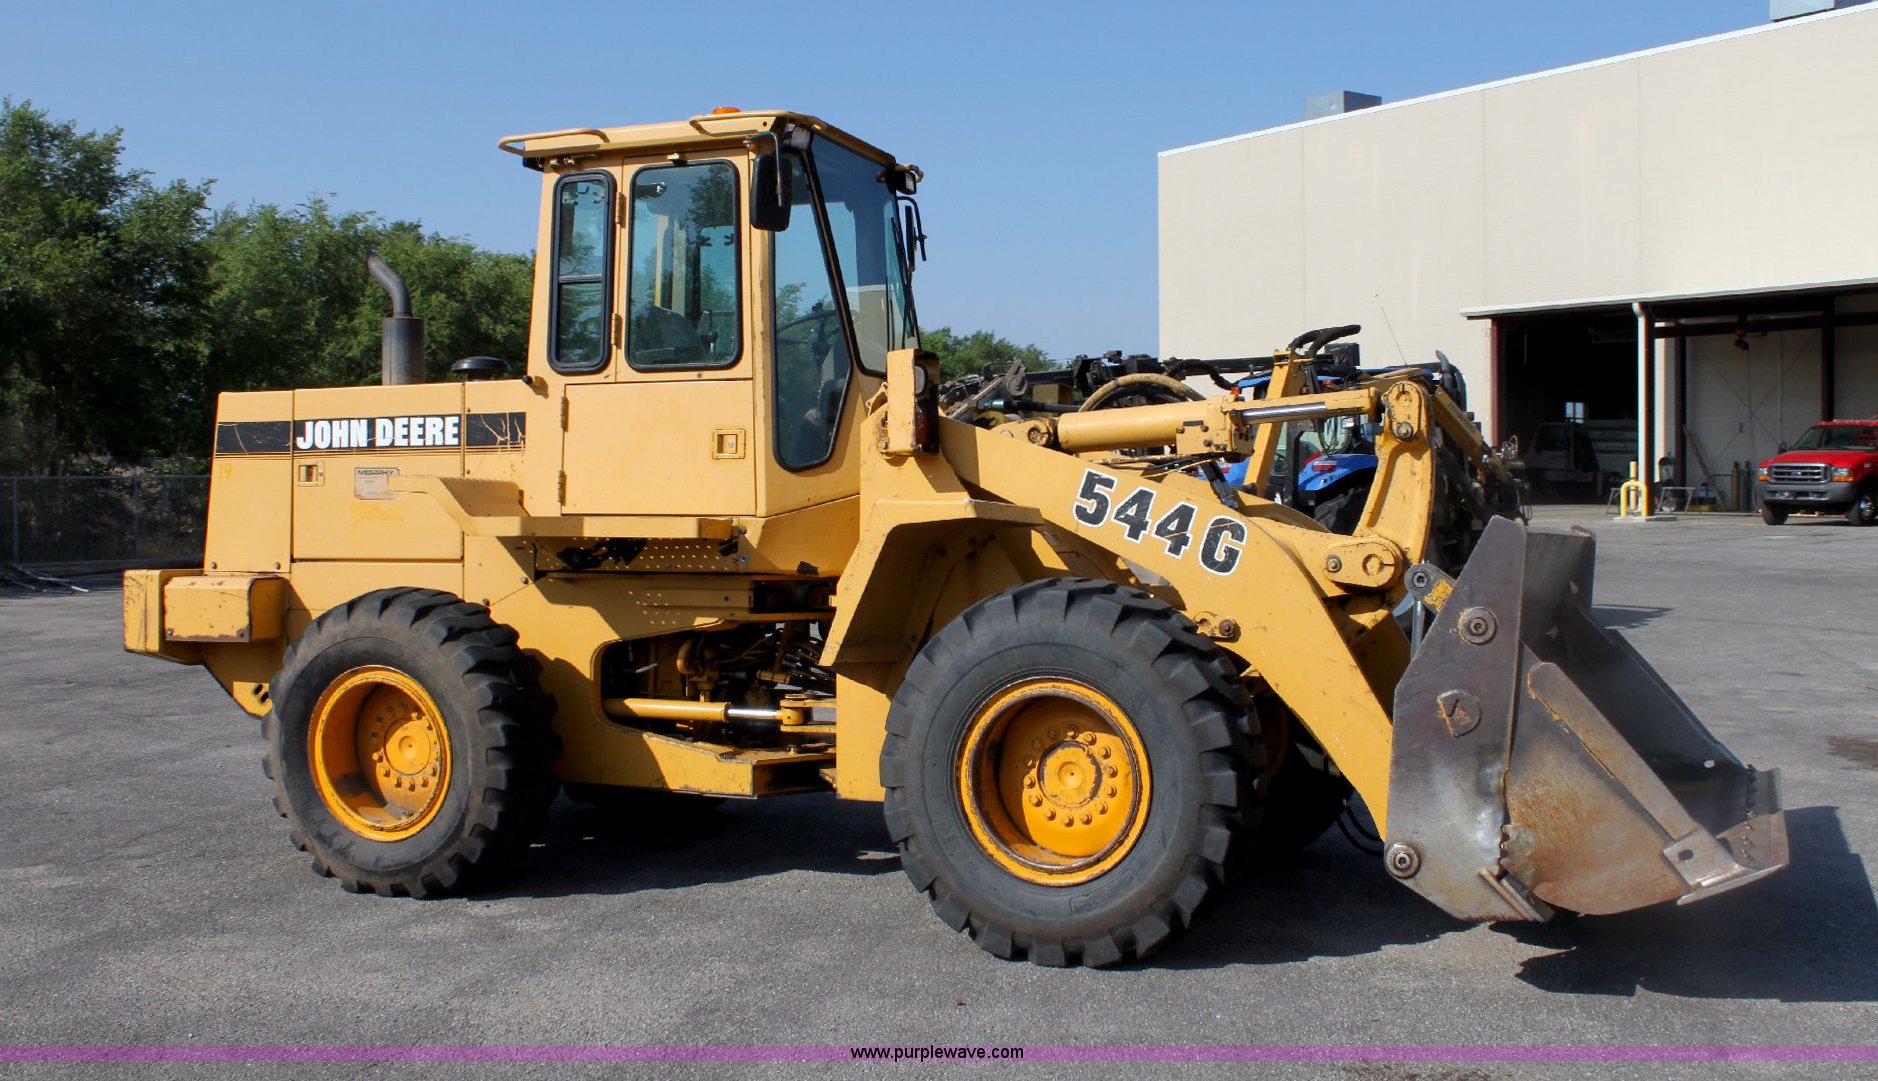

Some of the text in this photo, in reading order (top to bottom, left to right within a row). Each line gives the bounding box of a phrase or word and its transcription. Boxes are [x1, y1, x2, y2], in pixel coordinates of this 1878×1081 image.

[296, 416, 460, 450] JOHN DEERE
[1073, 468, 1247, 576] 544G
